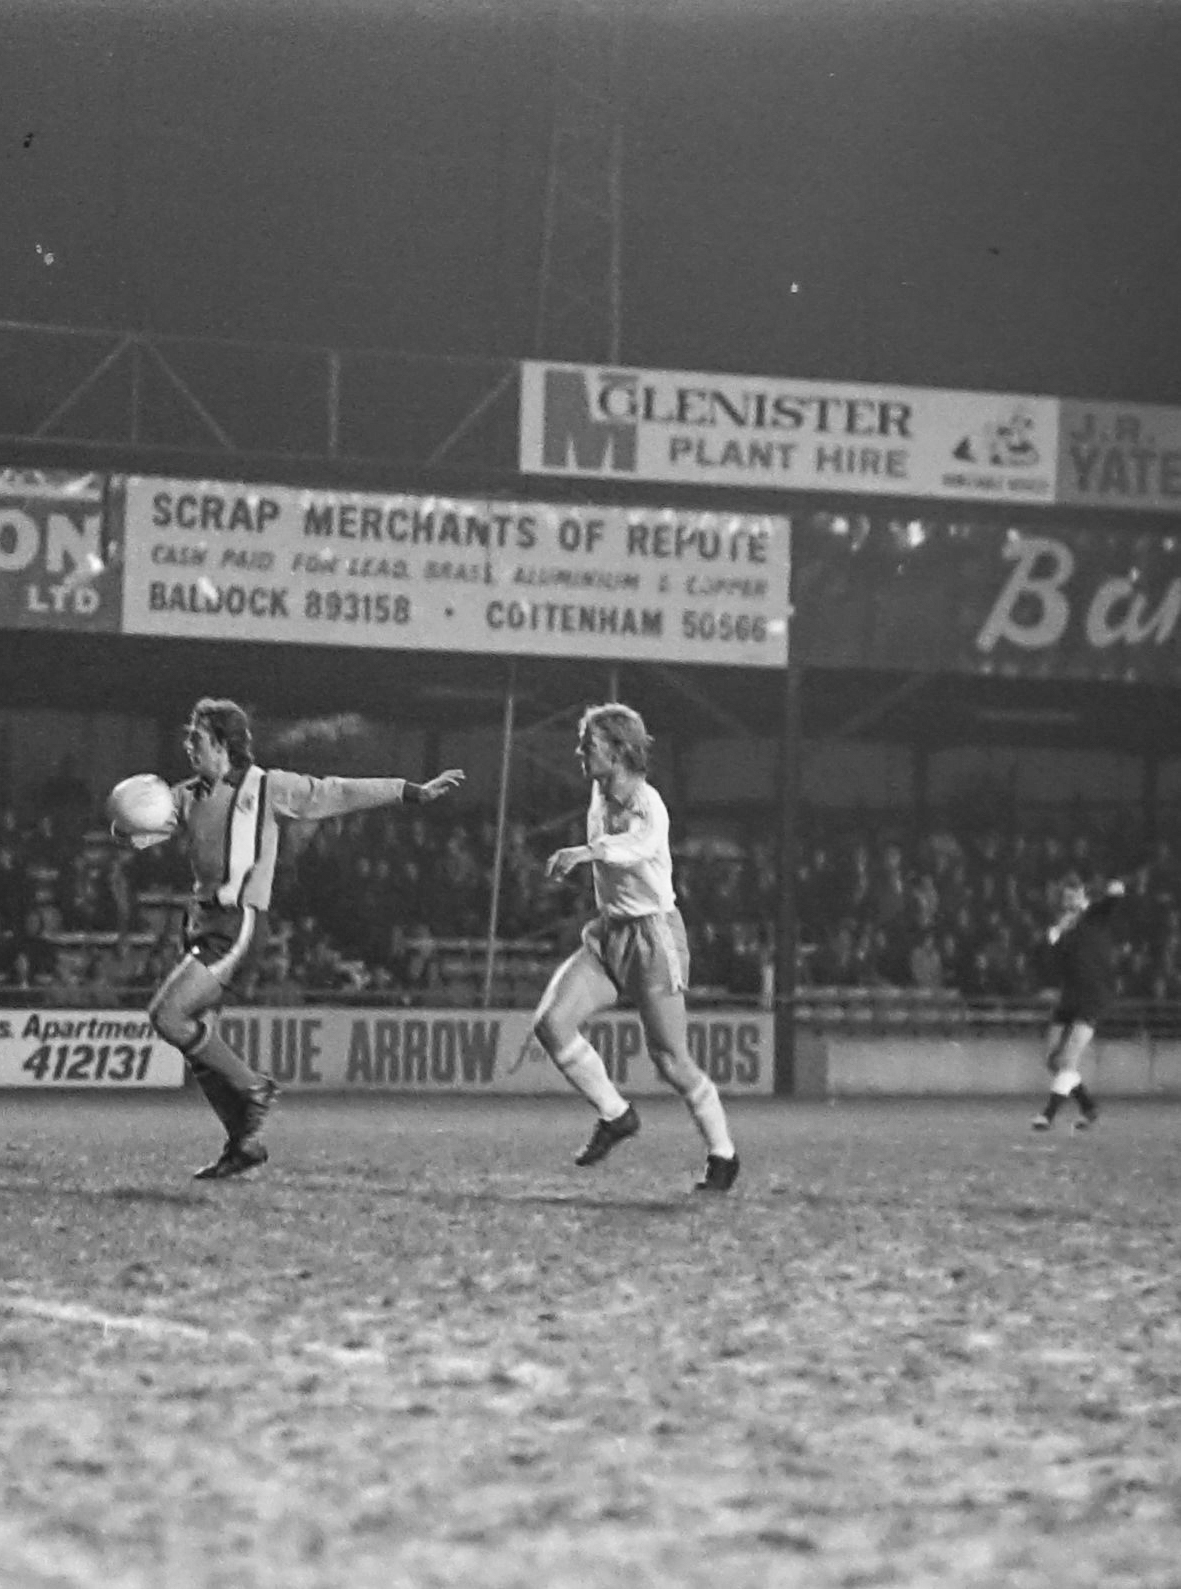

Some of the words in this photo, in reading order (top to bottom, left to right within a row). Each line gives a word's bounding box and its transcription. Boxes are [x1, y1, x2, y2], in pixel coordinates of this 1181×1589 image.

[598, 383, 914, 440] GLENISTER
[669, 435, 796, 473] PLANT
[816, 442, 908, 479] HIRE
[152, 491, 280, 533] SCRAP
[303, 501, 536, 549] MERCHANTS
[558, 518, 605, 553] OF
[27, 584, 100, 615] LTD
[21, 1012, 163, 1044] Apartmen
[21, 1043, 153, 1082] 412131
[346, 1019, 501, 1084] ARROW
